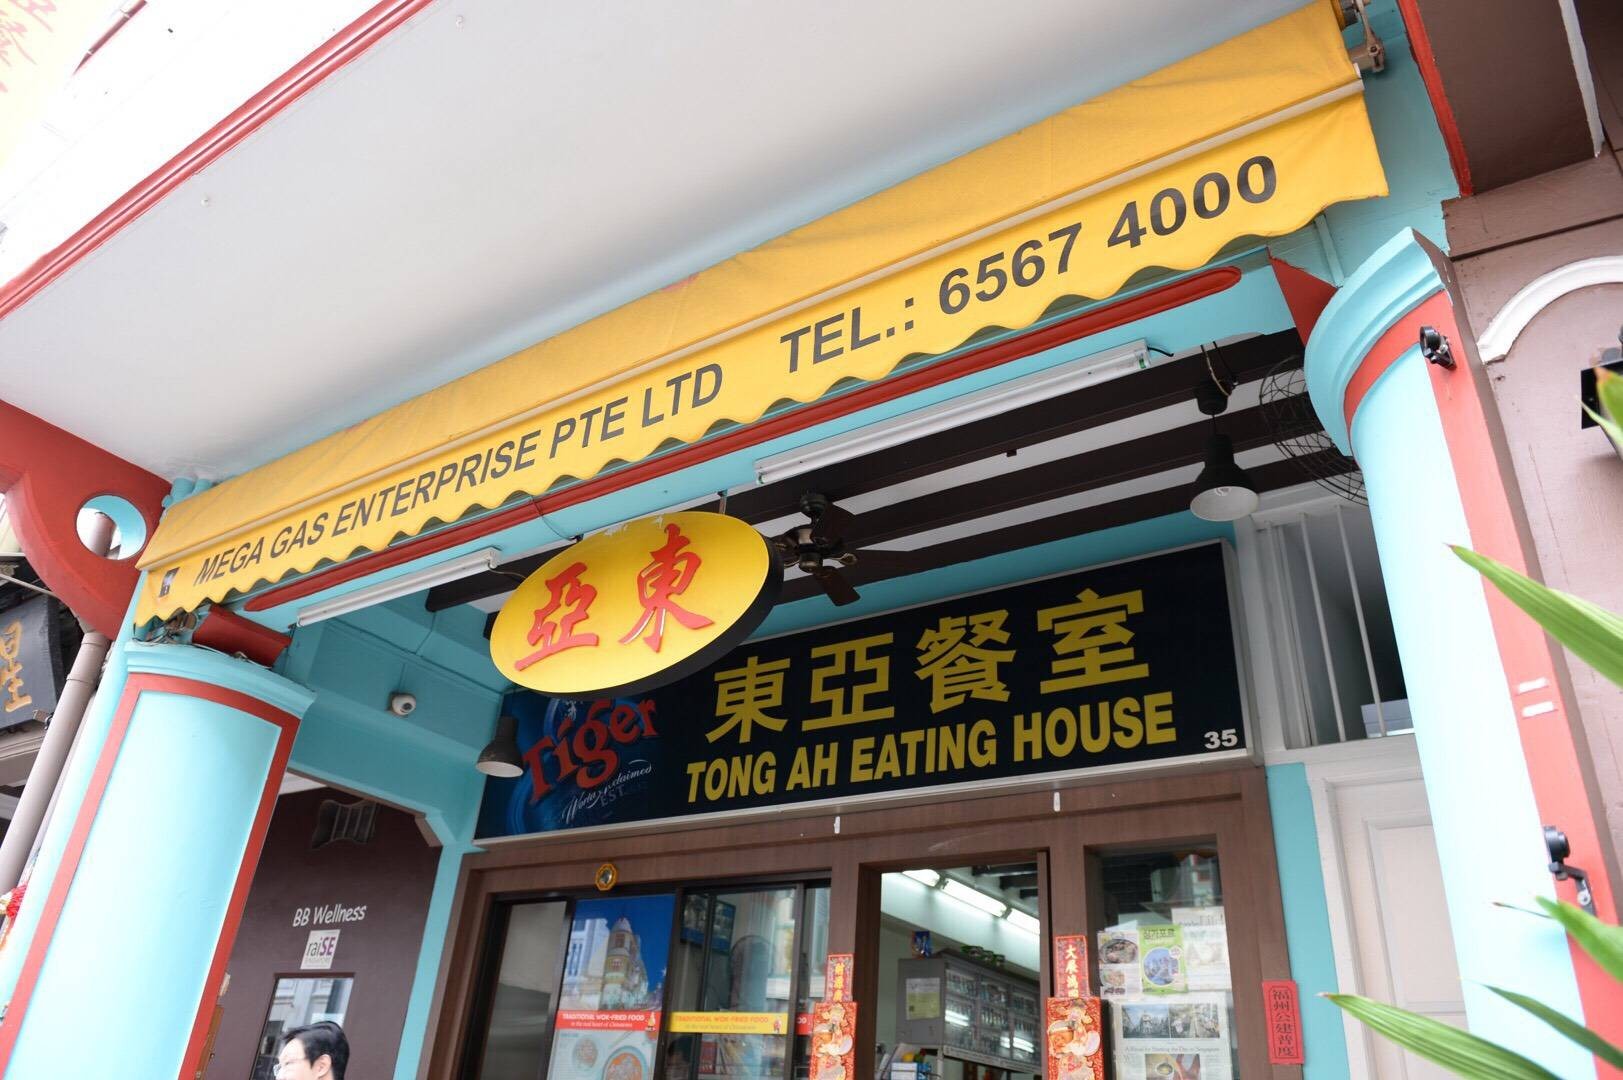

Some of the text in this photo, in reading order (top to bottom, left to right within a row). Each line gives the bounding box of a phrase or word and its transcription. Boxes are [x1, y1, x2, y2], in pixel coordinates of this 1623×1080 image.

[194, 542, 264, 586] MEGA
[270, 512, 329, 560] GAS
[332, 429, 541, 537] ENTERPRISE
[549, 396, 629, 458] PTE
[641, 362, 723, 429] LTD
[939, 223, 1082, 315] 6567
[1107, 155, 1277, 249] 4000
[705, 588, 1149, 744] 東亞餐室
[522, 698, 657, 806] Tiger
[687, 691, 1176, 803] TONG AH EATING HOUSE
[1204, 728, 1238, 750] 35
[293, 904, 367, 927] BB Wellness
[306, 936, 336, 957] raiSE
[628, 1013, 645, 1021] FOOD
